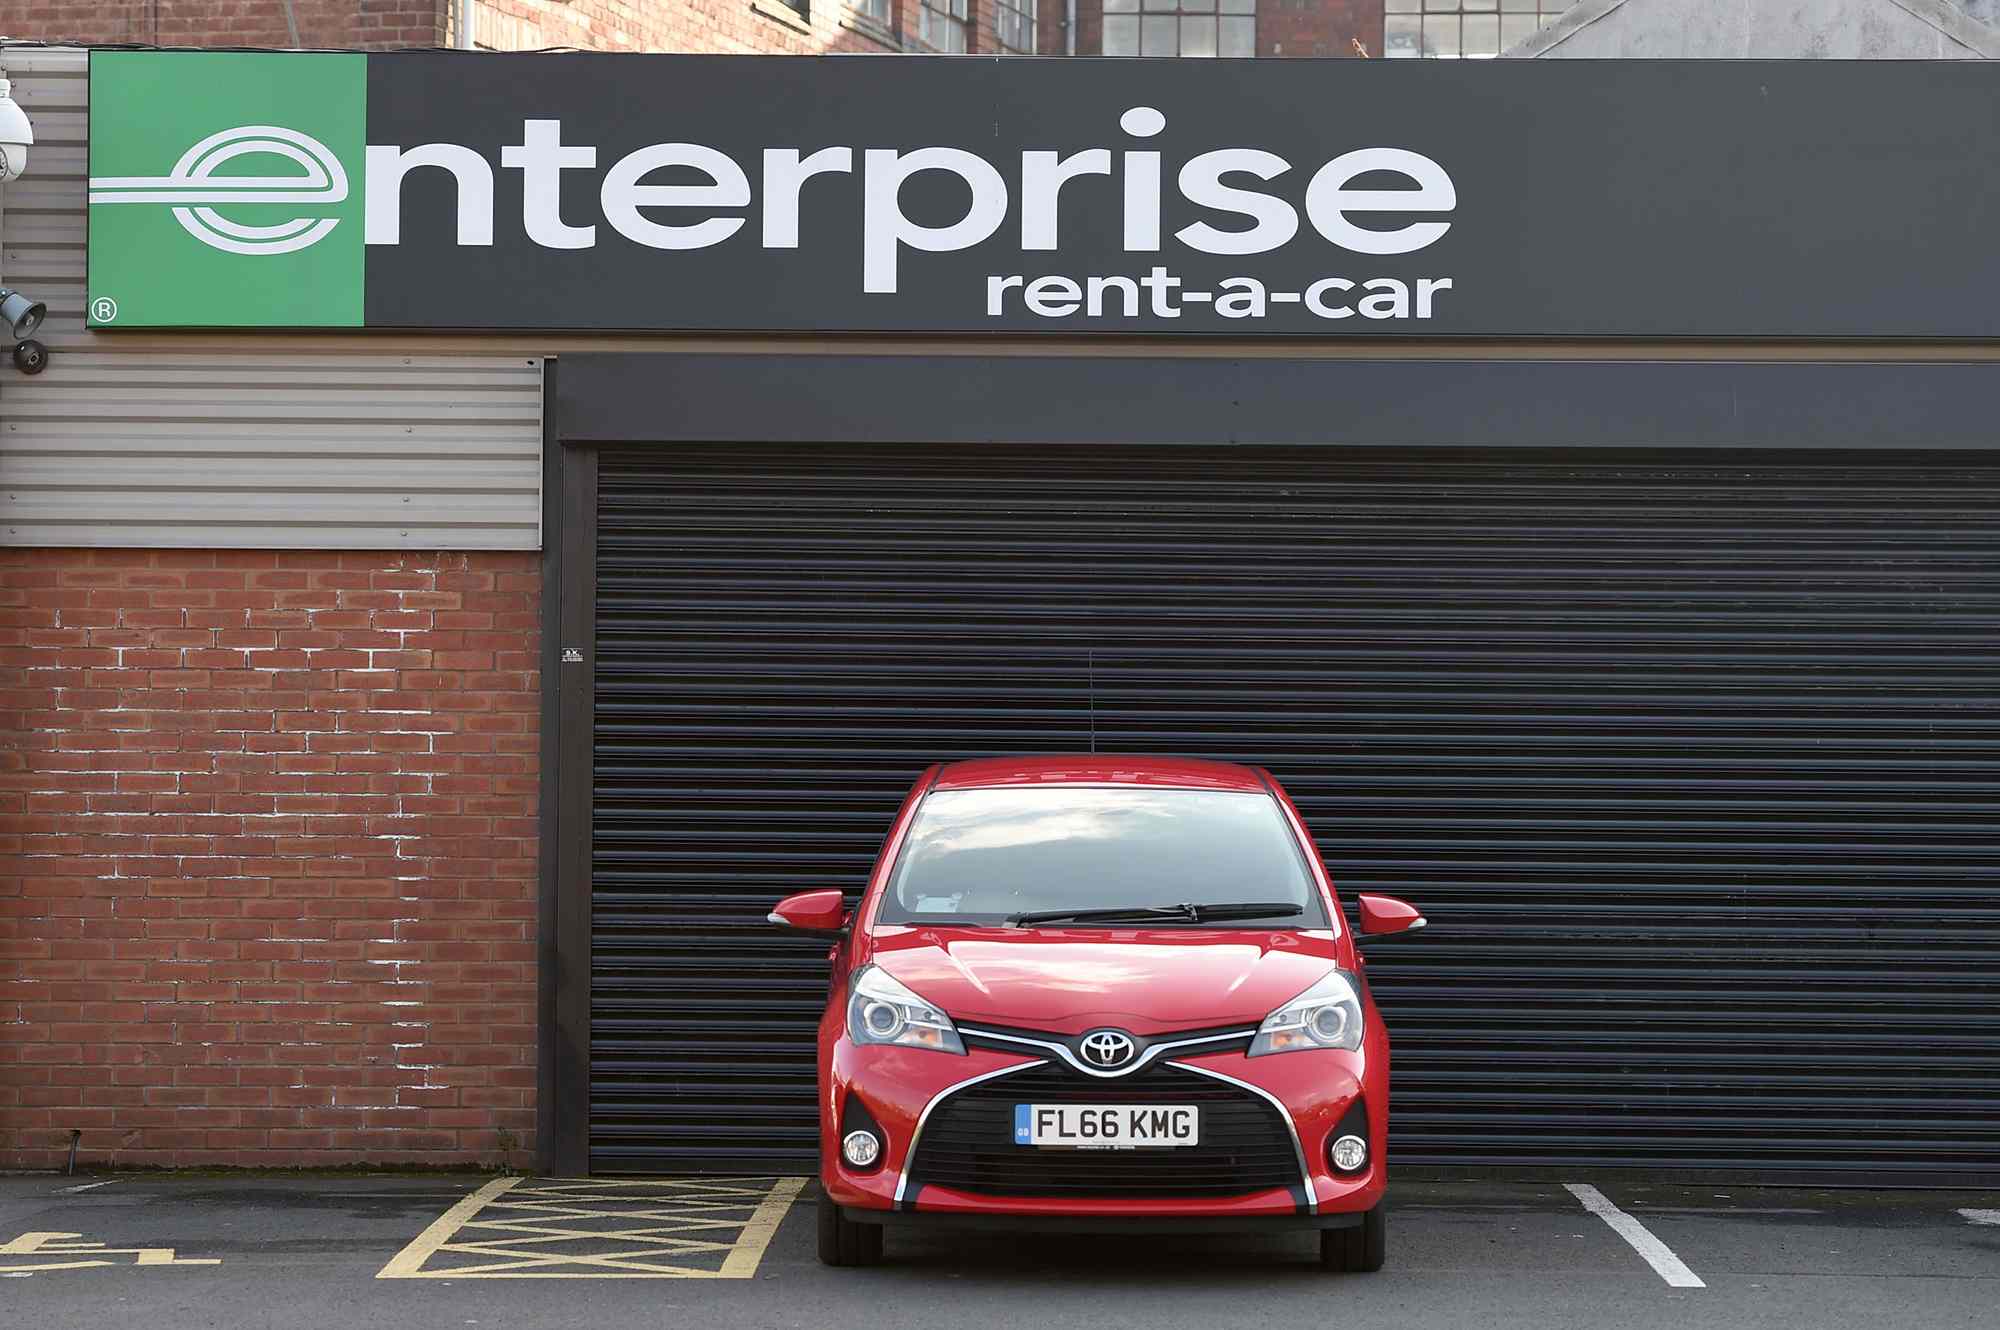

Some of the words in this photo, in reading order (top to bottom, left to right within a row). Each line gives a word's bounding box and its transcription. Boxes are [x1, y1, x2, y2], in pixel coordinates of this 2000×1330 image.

[168, 107, 1457, 294] enterprise
[987, 267, 1453, 319] rent-a-car
[1037, 1109, 1119, 1138] FL66
[1130, 1110, 1190, 1138] KMG
